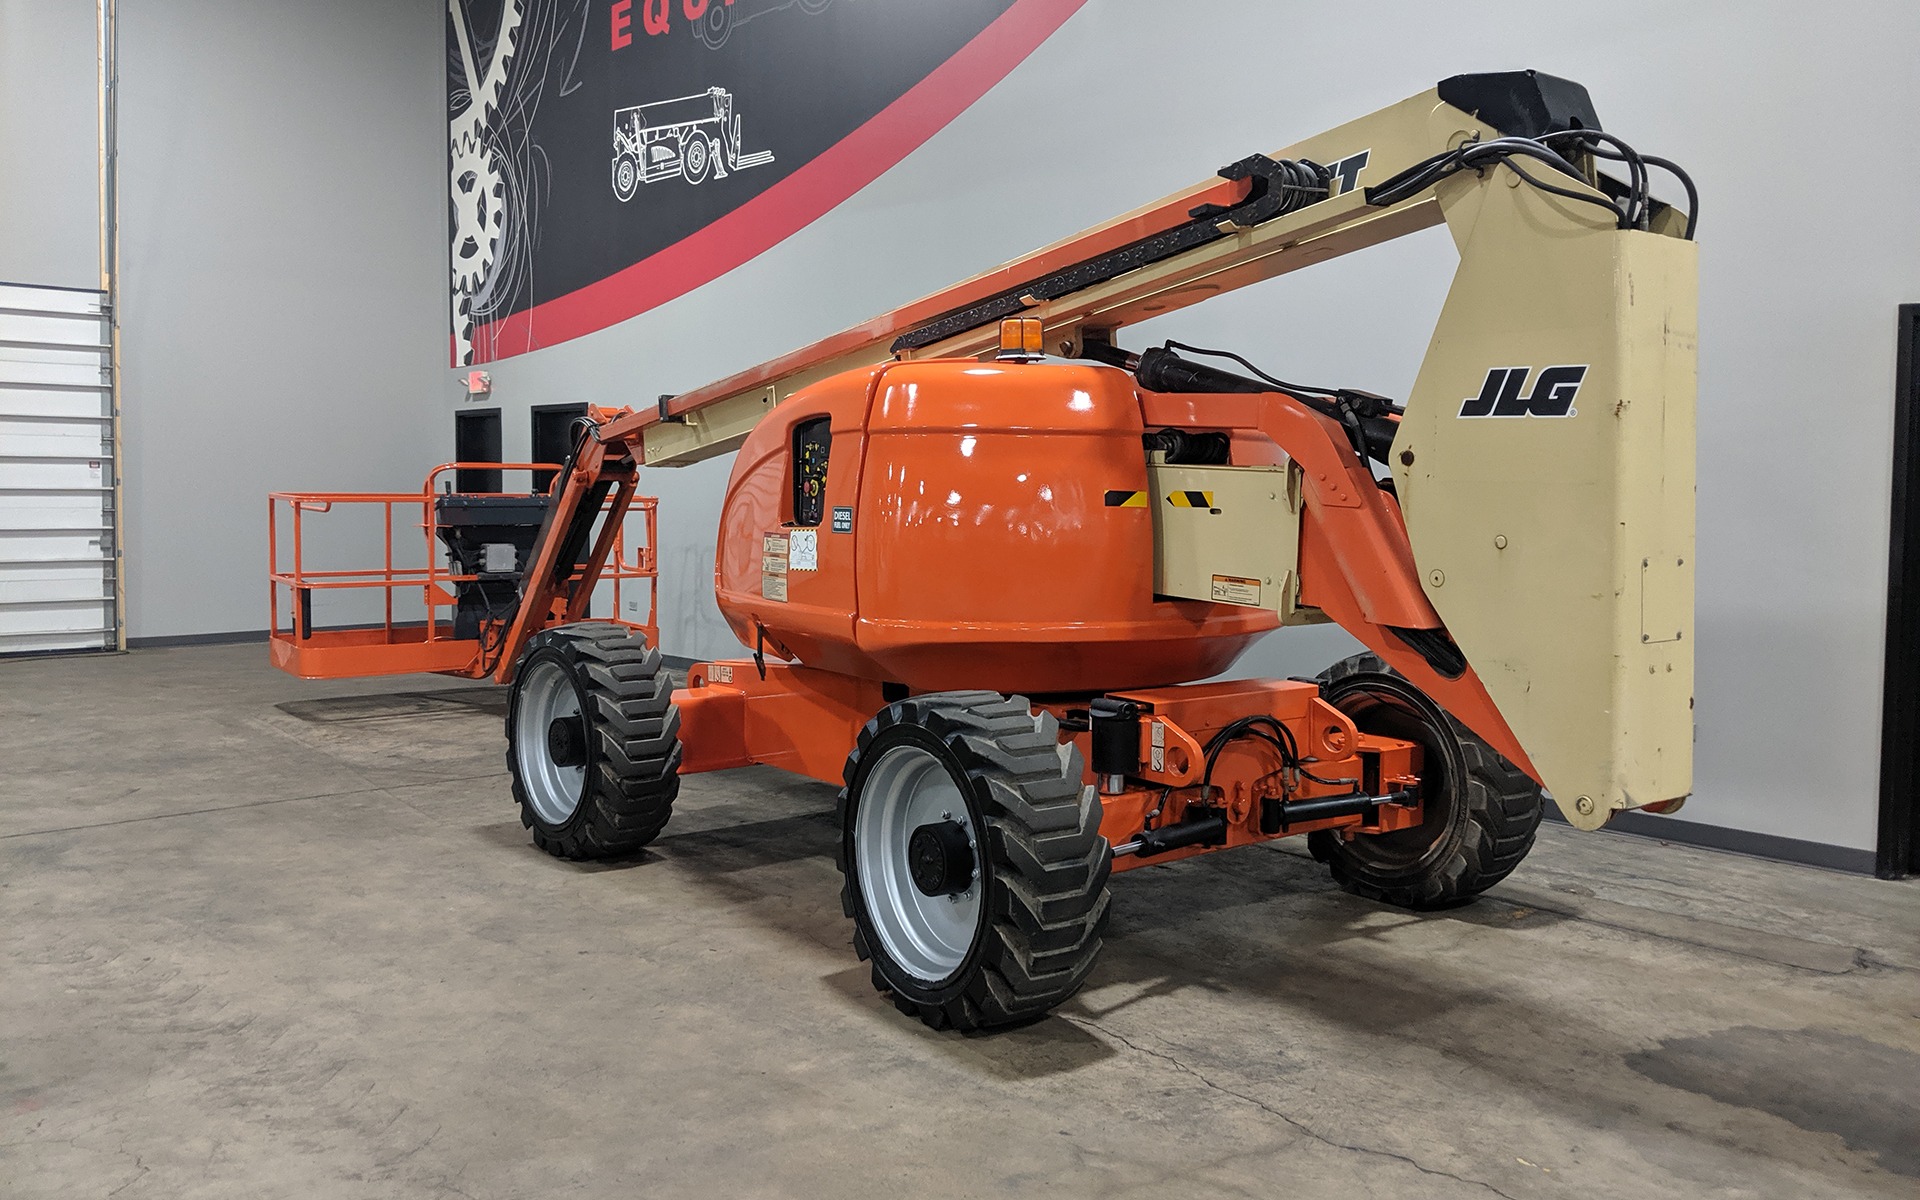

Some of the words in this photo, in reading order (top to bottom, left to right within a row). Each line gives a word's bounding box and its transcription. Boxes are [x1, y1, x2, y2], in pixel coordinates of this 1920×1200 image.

[611, 0, 734, 51] EQU
[1458, 365, 1588, 417] JLG
[834, 511, 851, 520] DIESEL
